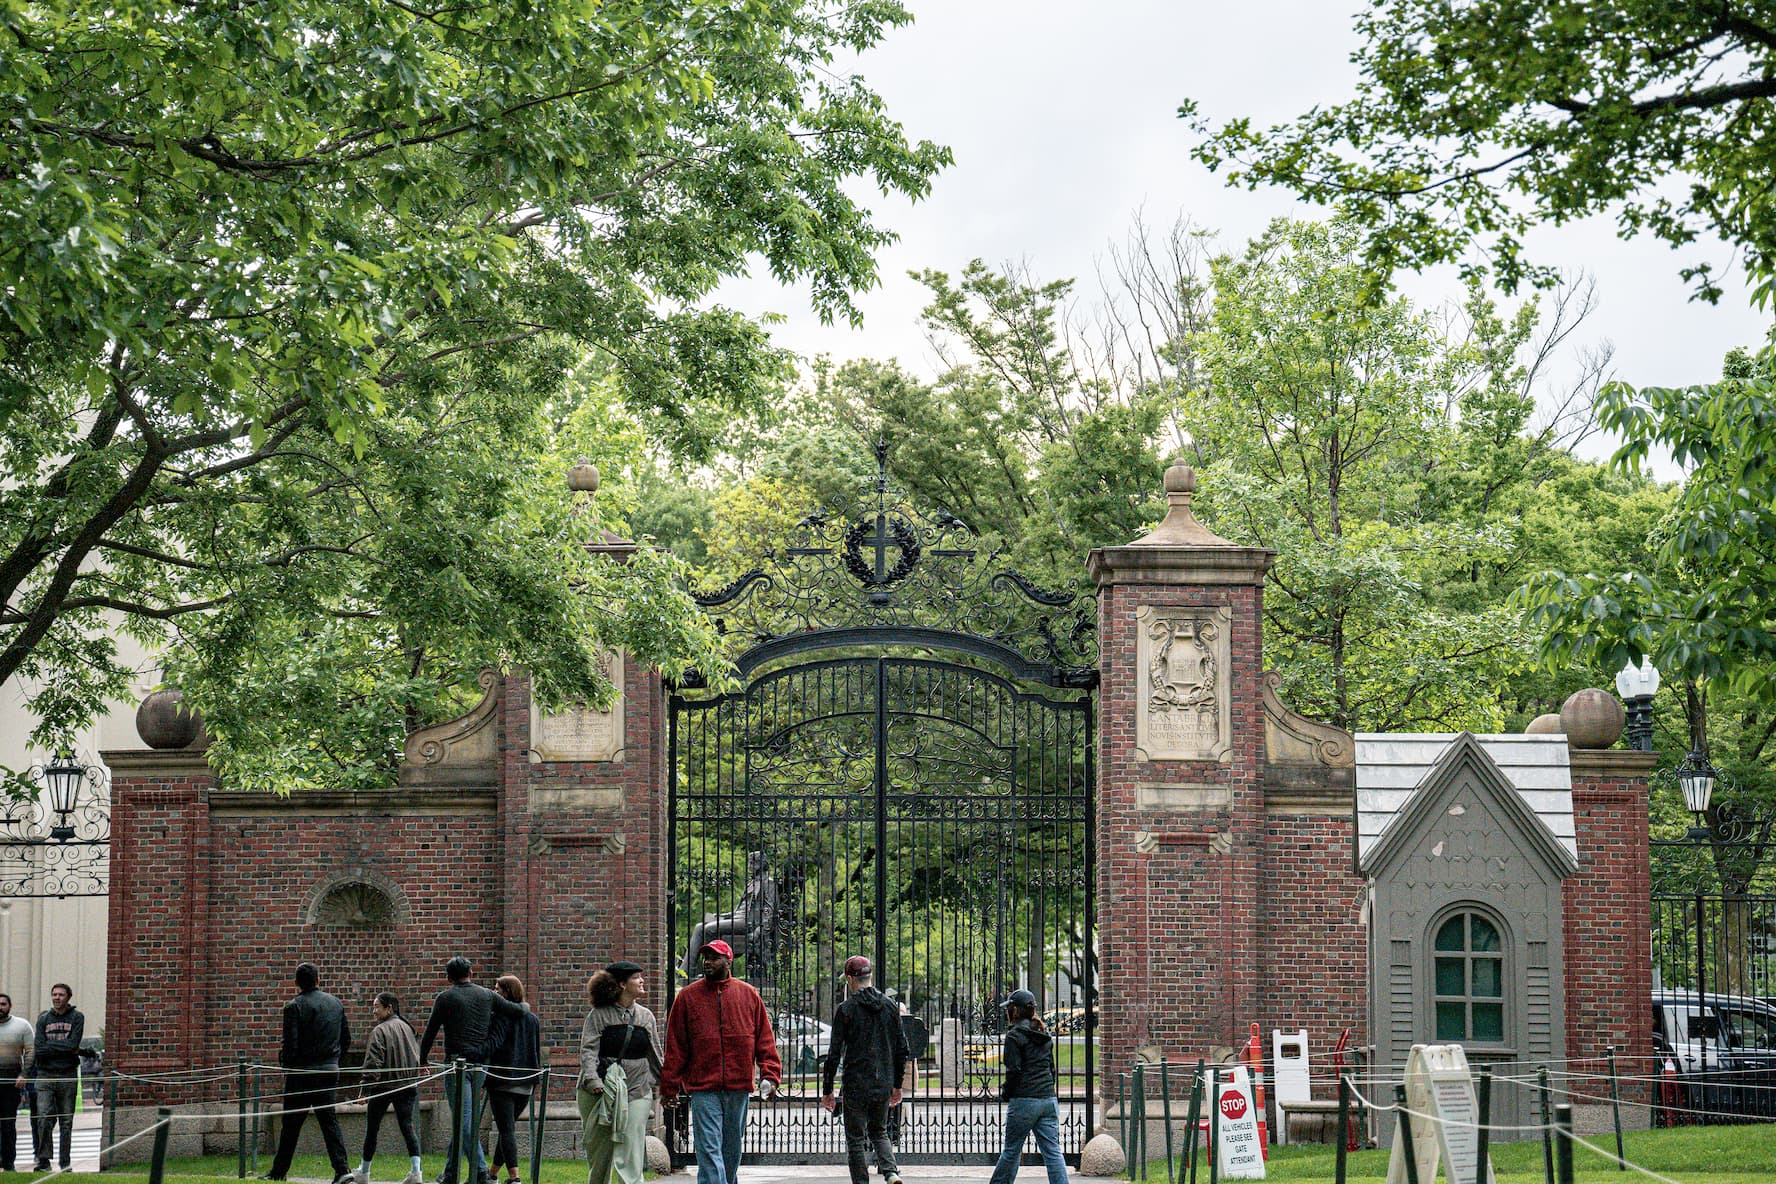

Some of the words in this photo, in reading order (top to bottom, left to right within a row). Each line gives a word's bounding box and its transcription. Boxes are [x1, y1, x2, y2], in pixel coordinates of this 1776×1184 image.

[1221, 1098, 1245, 1112] STOP
[1222, 1123, 1231, 1132] ALL
[1231, 1121, 1253, 1131] VEHICLES
[1226, 1134, 1243, 1143] PLEASE
[1243, 1132, 1253, 1141] SEE
[1235, 1144, 1247, 1153] GATE
[1231, 1154, 1256, 1165] ATTENDANT
